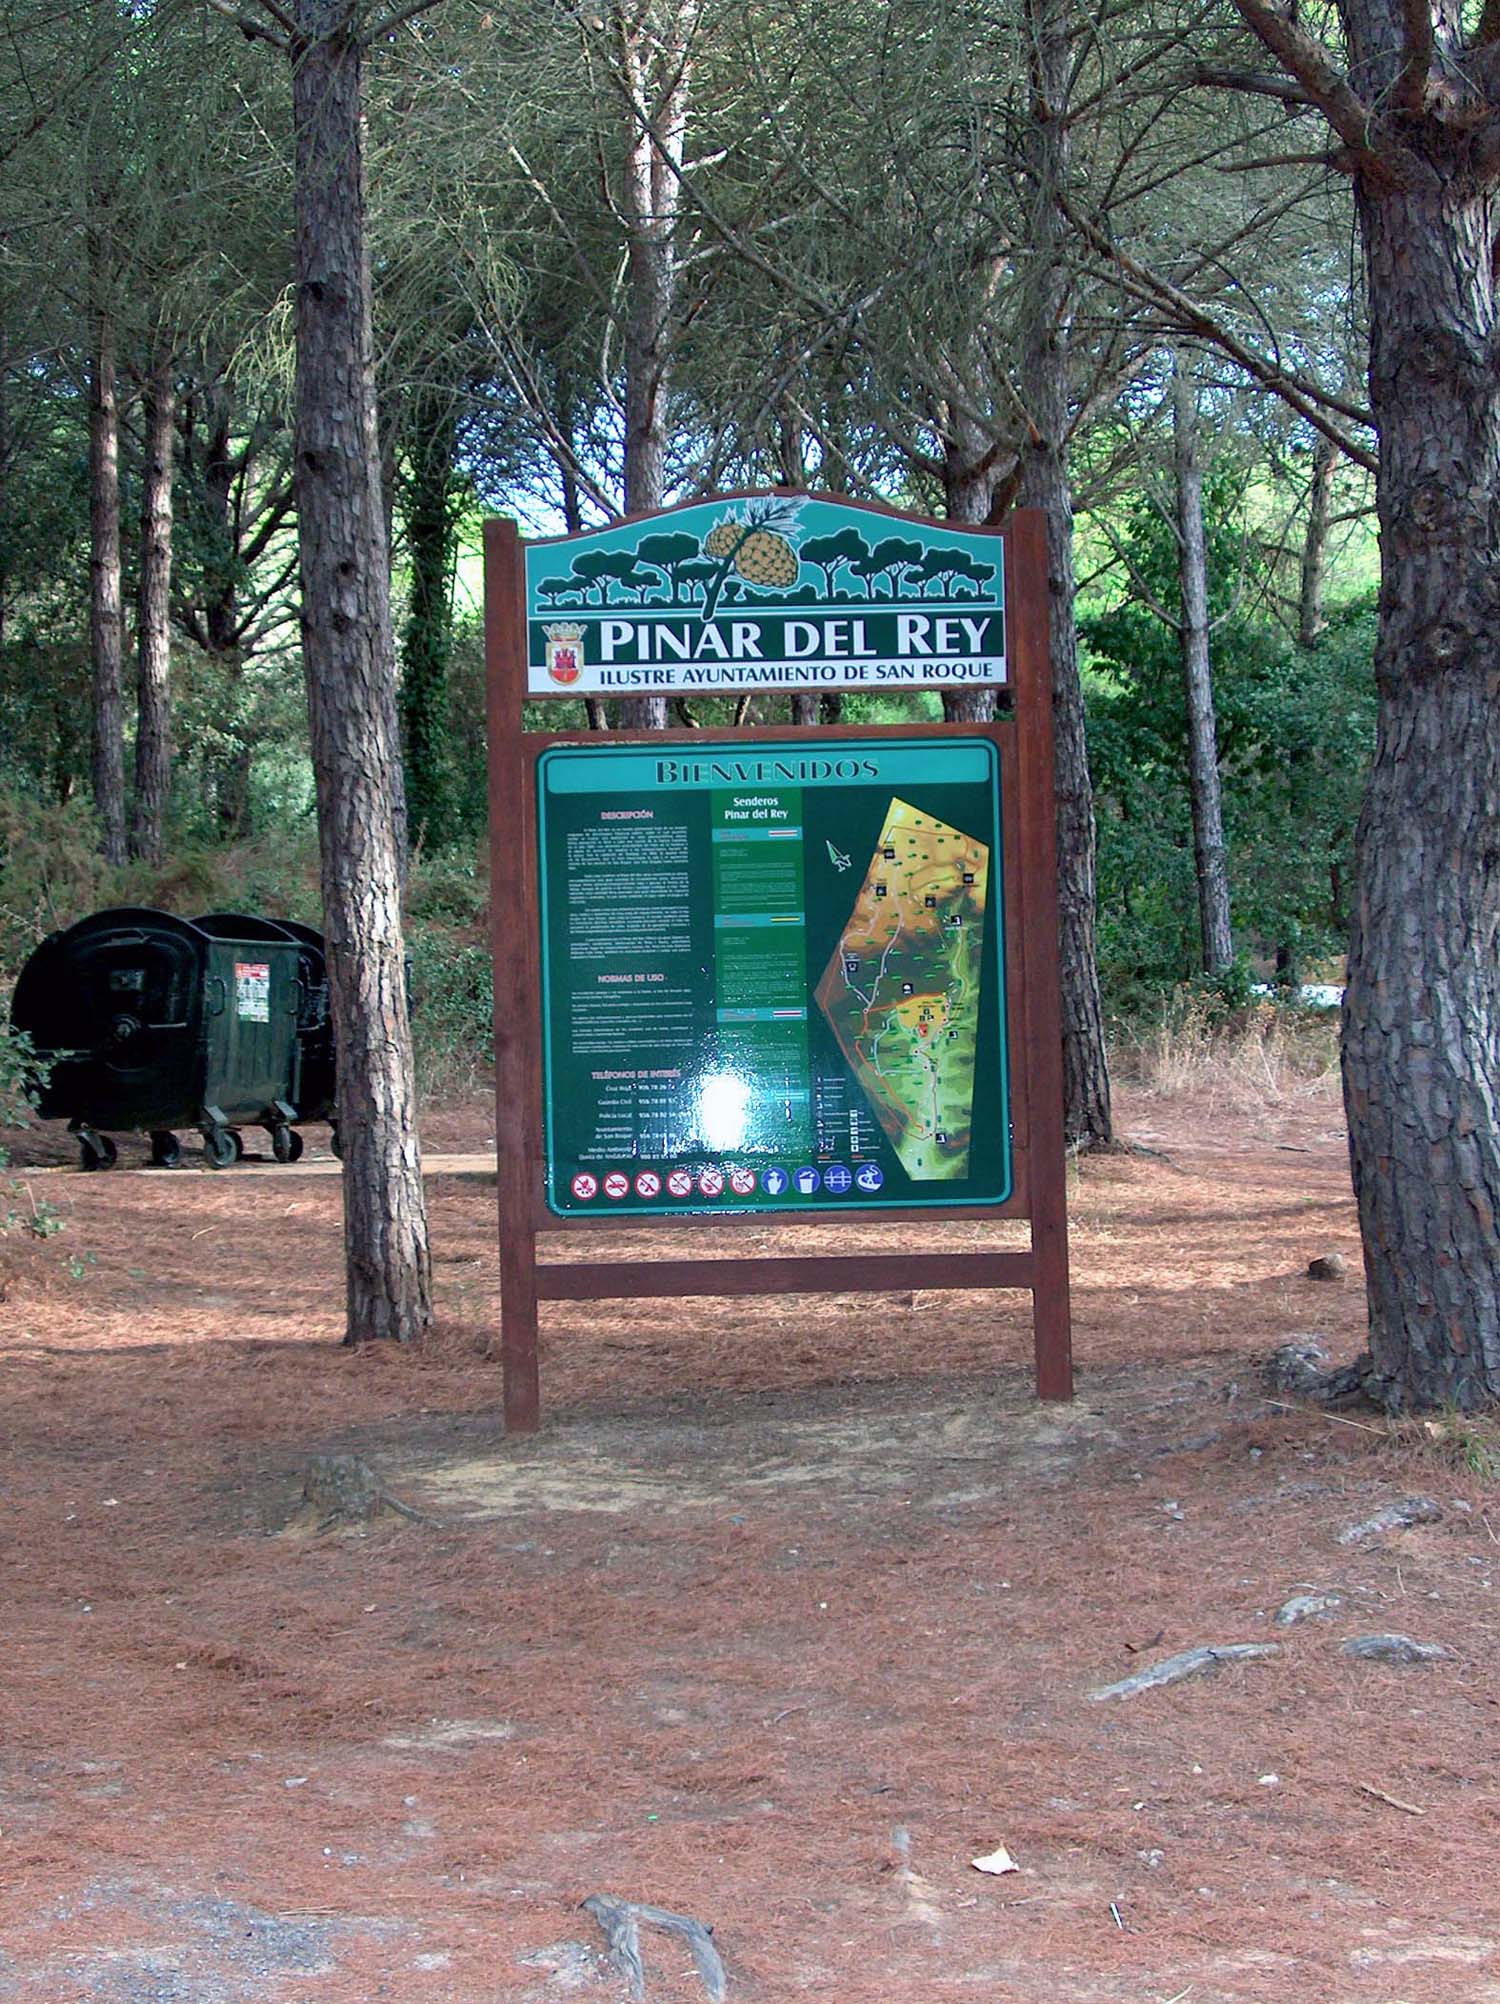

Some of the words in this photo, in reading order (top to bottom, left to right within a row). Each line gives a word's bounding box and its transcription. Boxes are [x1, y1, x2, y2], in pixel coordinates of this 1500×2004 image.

[600, 620, 764, 661] PINAR
[783, 619, 877, 657] DEL
[897, 614, 991, 655] REY
[600, 669, 676, 685] ILUSTRE
[682, 665, 836, 683] AYUNTAMIENTO
[844, 665, 869, 680] DE
[876, 664, 915, 679] SAN
[923, 663, 993, 680] ROQUE
[655, 758, 880, 785] BIENVENIDOS
[733, 796, 779, 807] Senderos
[724, 810, 750, 820] Pinar
[752, 808, 768, 819] del
[770, 808, 789, 820] Rey
[597, 974, 633, 983] NORMAS
[634, 974, 646, 983] DE
[646, 973, 665, 982] USO
[591, 1070, 636, 1080] TELÉFONOS
[637, 1070, 649, 1079] DE
